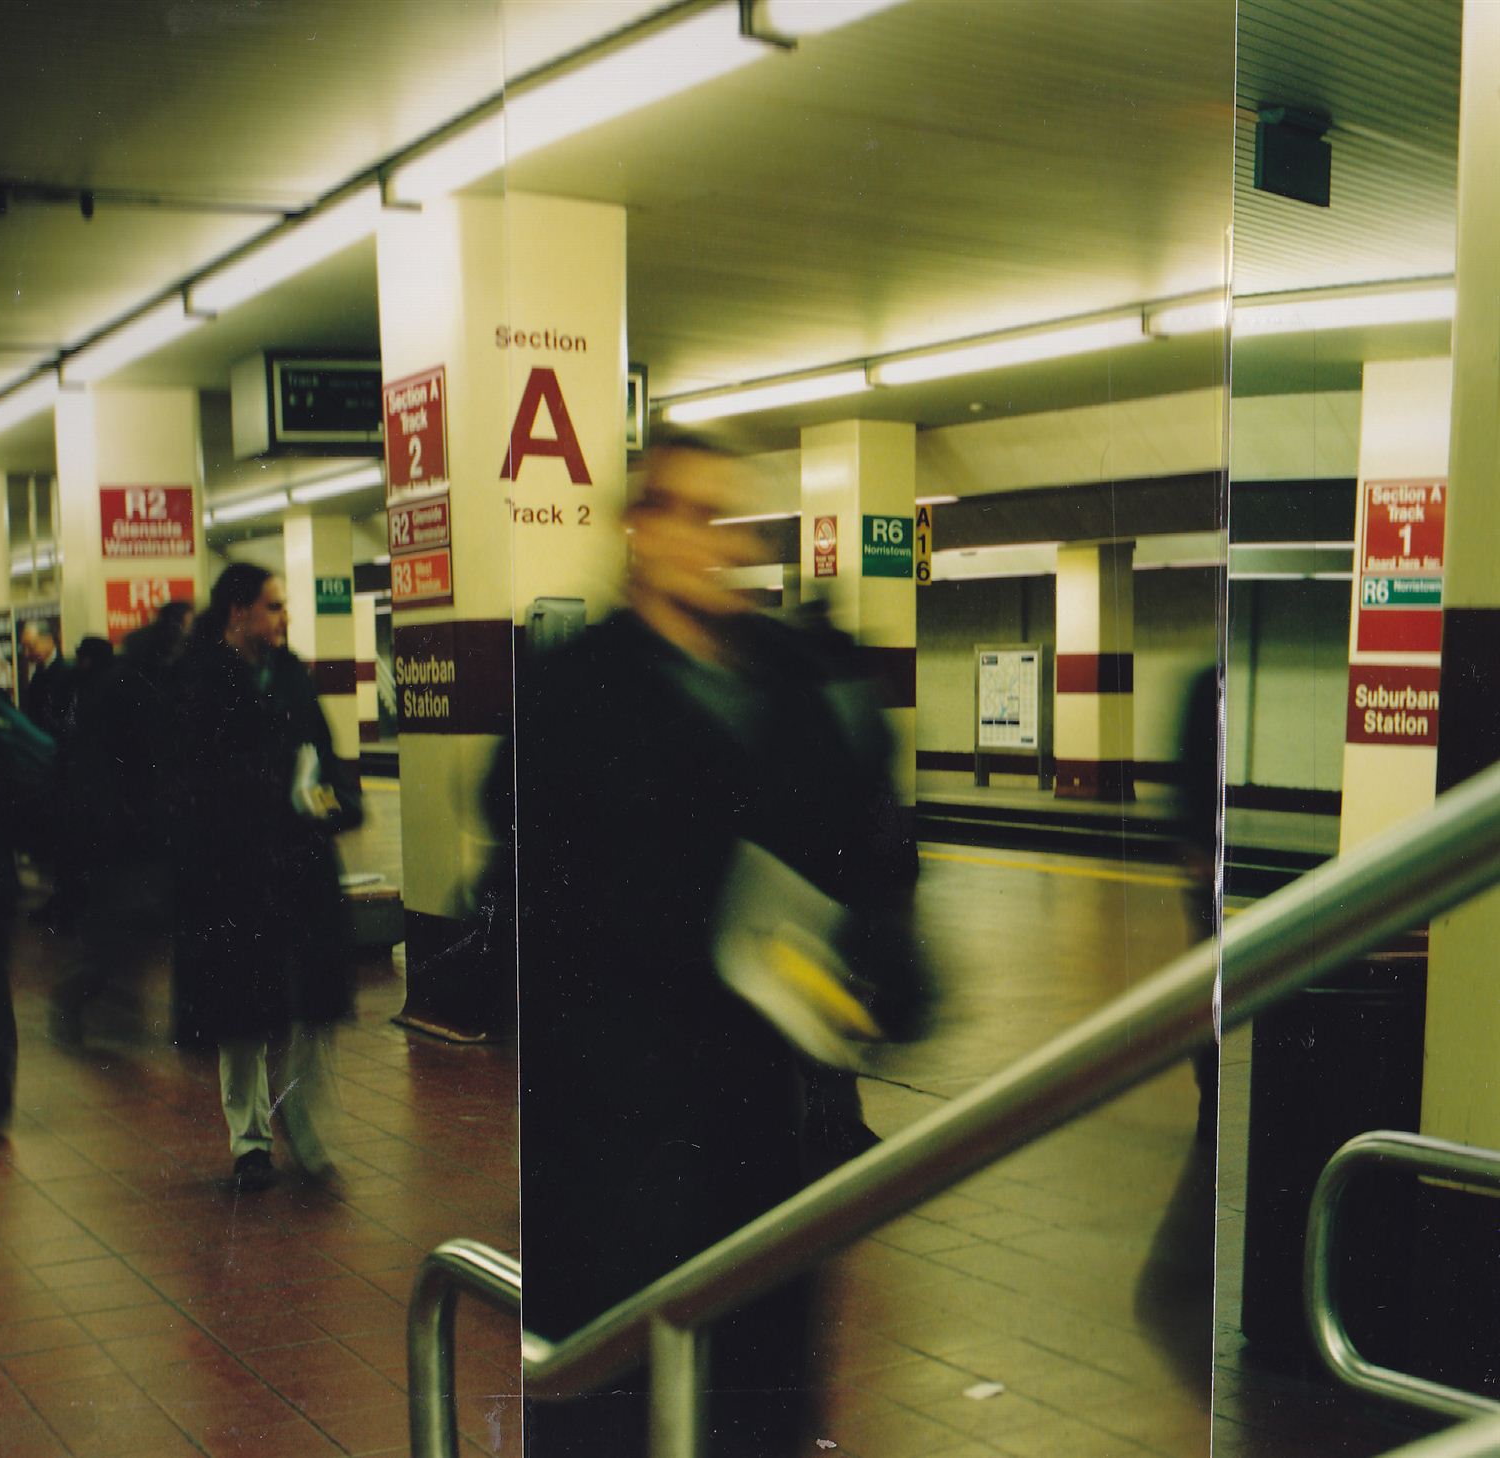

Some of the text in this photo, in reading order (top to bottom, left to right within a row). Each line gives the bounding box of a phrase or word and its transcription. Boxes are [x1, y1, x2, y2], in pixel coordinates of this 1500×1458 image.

[495, 326, 587, 352] Section
[389, 384, 428, 416] Section
[430, 376, 439, 401] A
[401, 406, 428, 435] Track
[499, 367, 593, 486] A
[409, 435, 423, 479] 2
[125, 487, 167, 519] R2
[1372, 483, 1442, 504] Section A
[577, 504, 592, 526] 2
[1387, 503, 1425, 523] Track
[112, 519, 182, 538] Glenside
[392, 512, 410, 545] R2
[872, 518, 904, 544] R6
[1399, 523, 1412, 556] 1
[105, 536, 192, 557] Warminster
[864, 543, 912, 557] Norristown
[394, 563, 412, 593] R3
[1364, 578, 1389, 603] R6
[130, 577, 171, 609] R3
[396, 655, 455, 685] Suburban
[404, 689, 449, 718] Station
[1355, 683, 1440, 711] Suburban
[1364, 709, 1428, 736] Station
